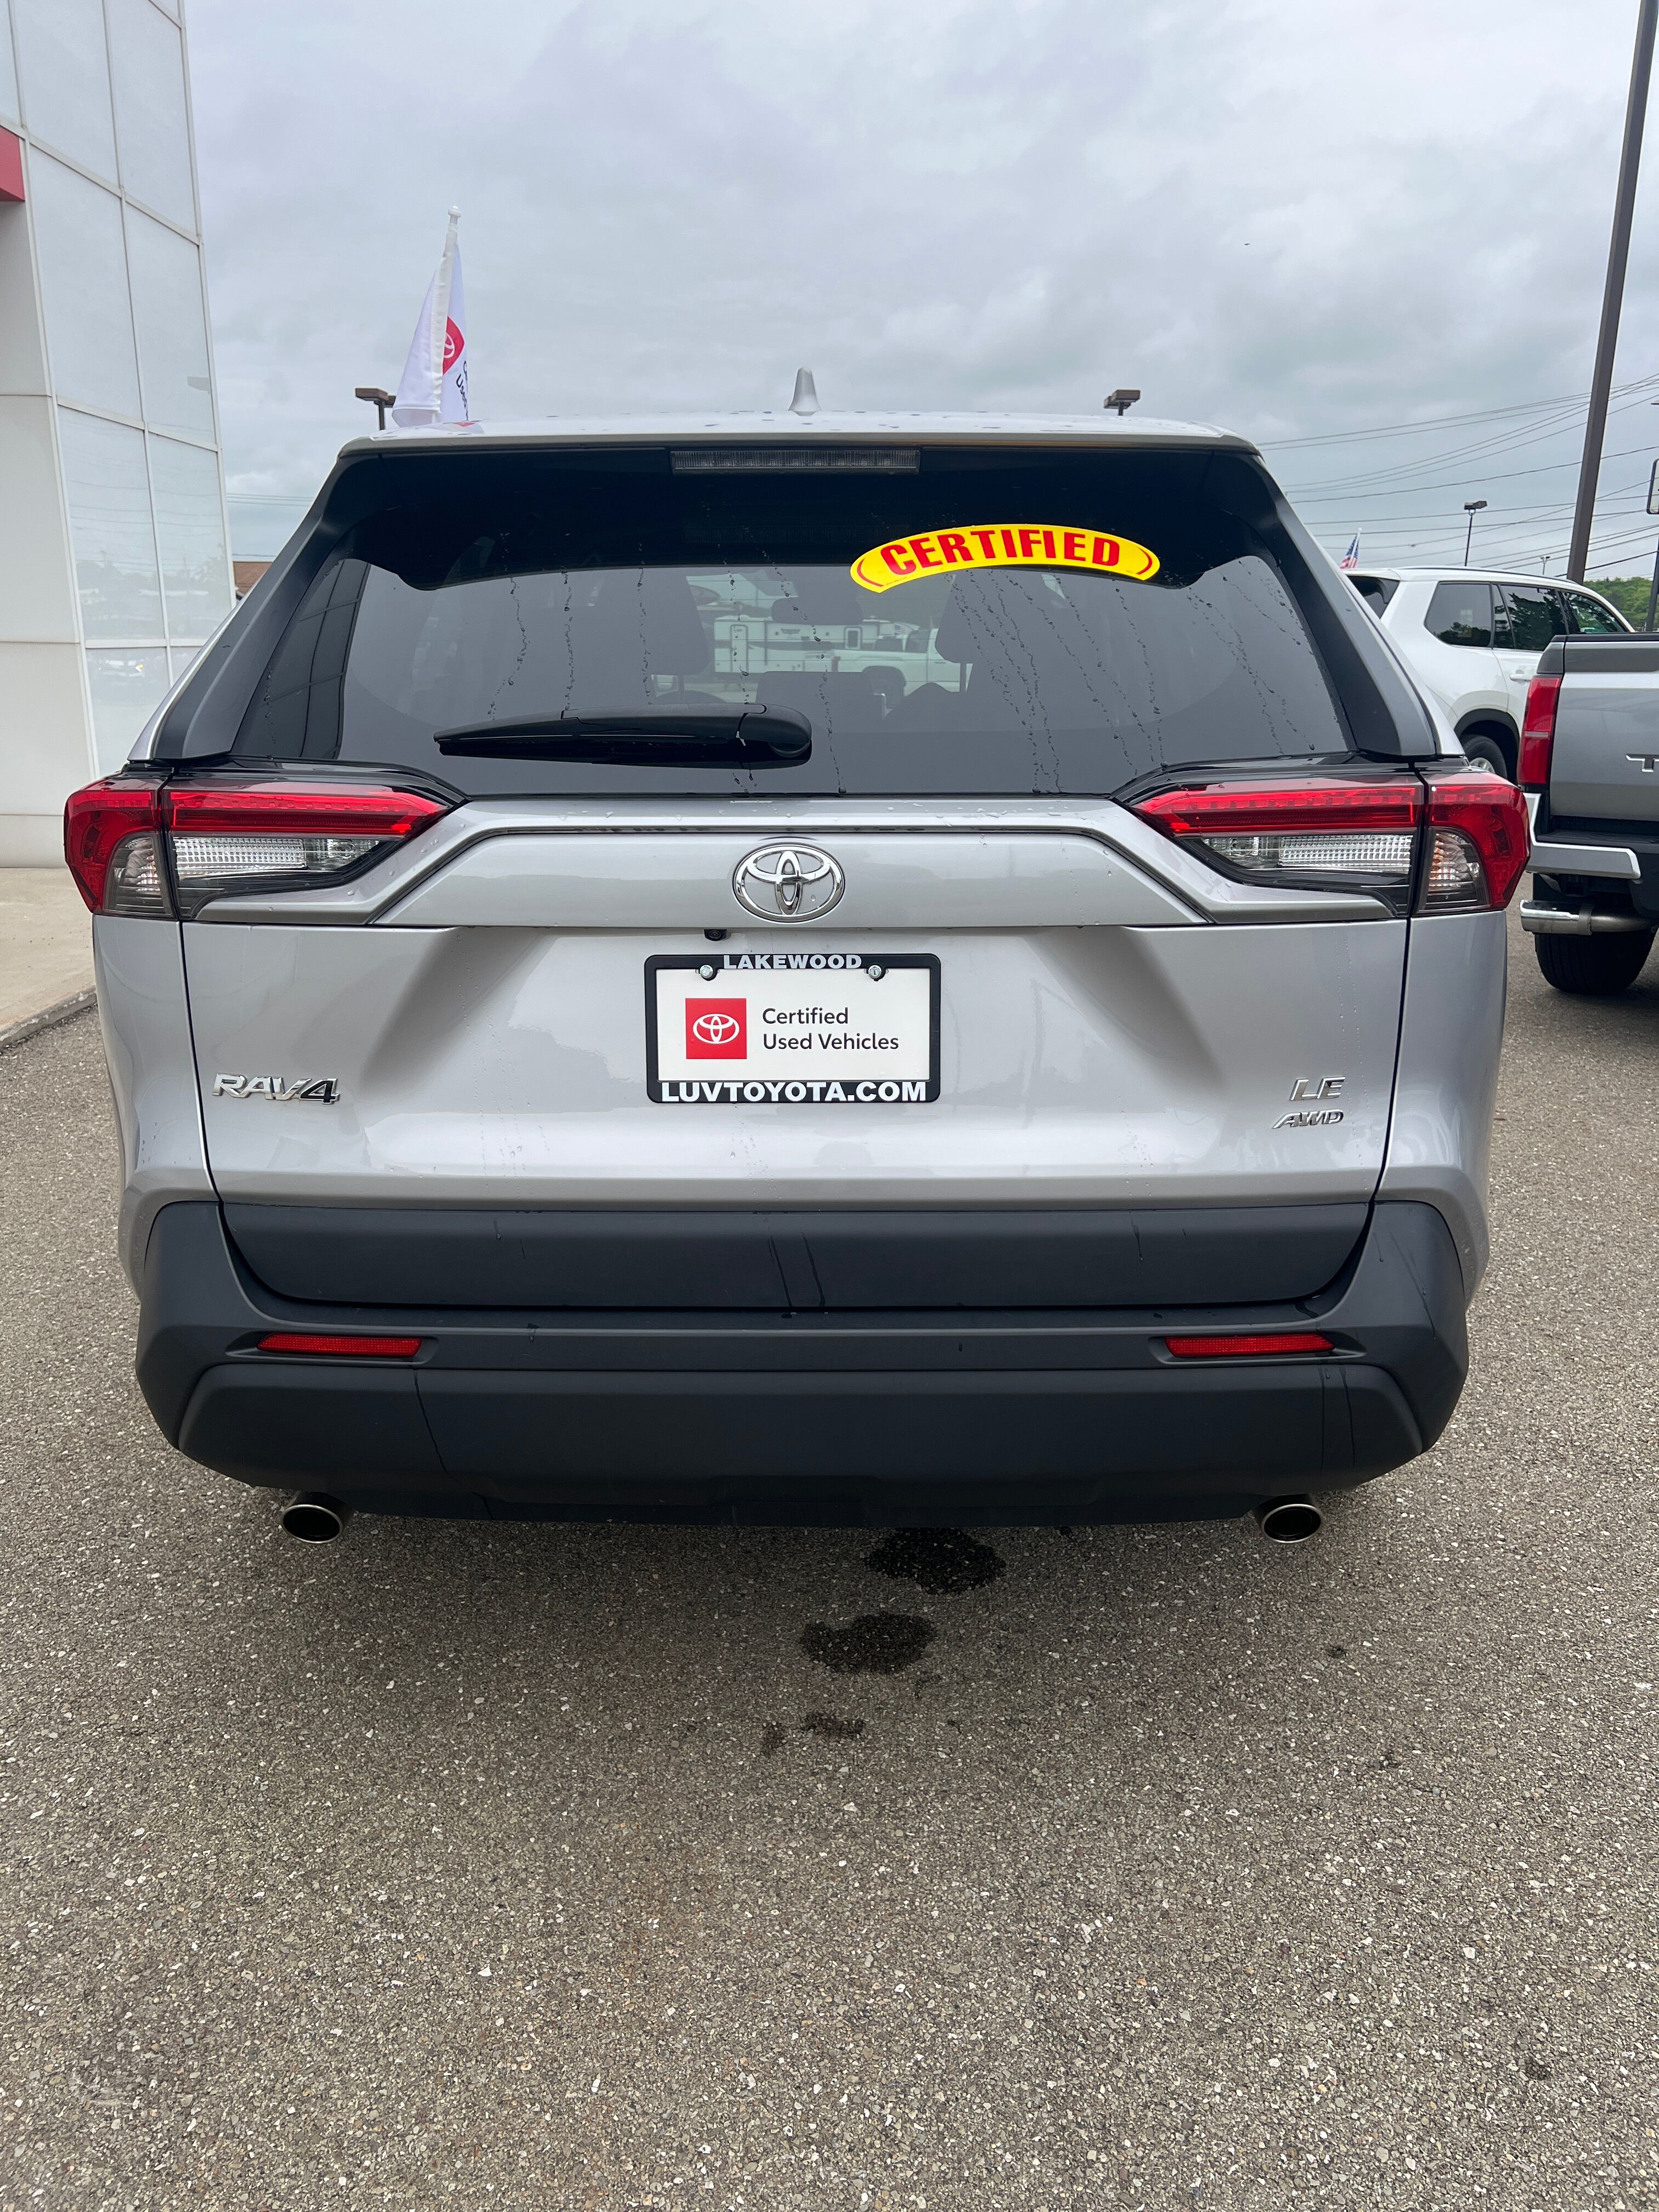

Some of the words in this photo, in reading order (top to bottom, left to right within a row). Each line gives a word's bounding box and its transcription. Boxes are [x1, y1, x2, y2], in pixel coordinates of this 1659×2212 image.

[881, 529, 1120, 575] CERTIFIED
[723, 954, 862, 969] LAKEWOOD
[762, 1007, 848, 1024] Certified
[763, 1033, 812, 1049] Used
[818, 1032, 899, 1049] Vehicles
[212, 1071, 341, 1104] RAV4
[661, 1081, 926, 1102] LUVTOYOTA.COM
[1289, 1076, 1346, 1101] LE
[1272, 1109, 1344, 1128] AWD
